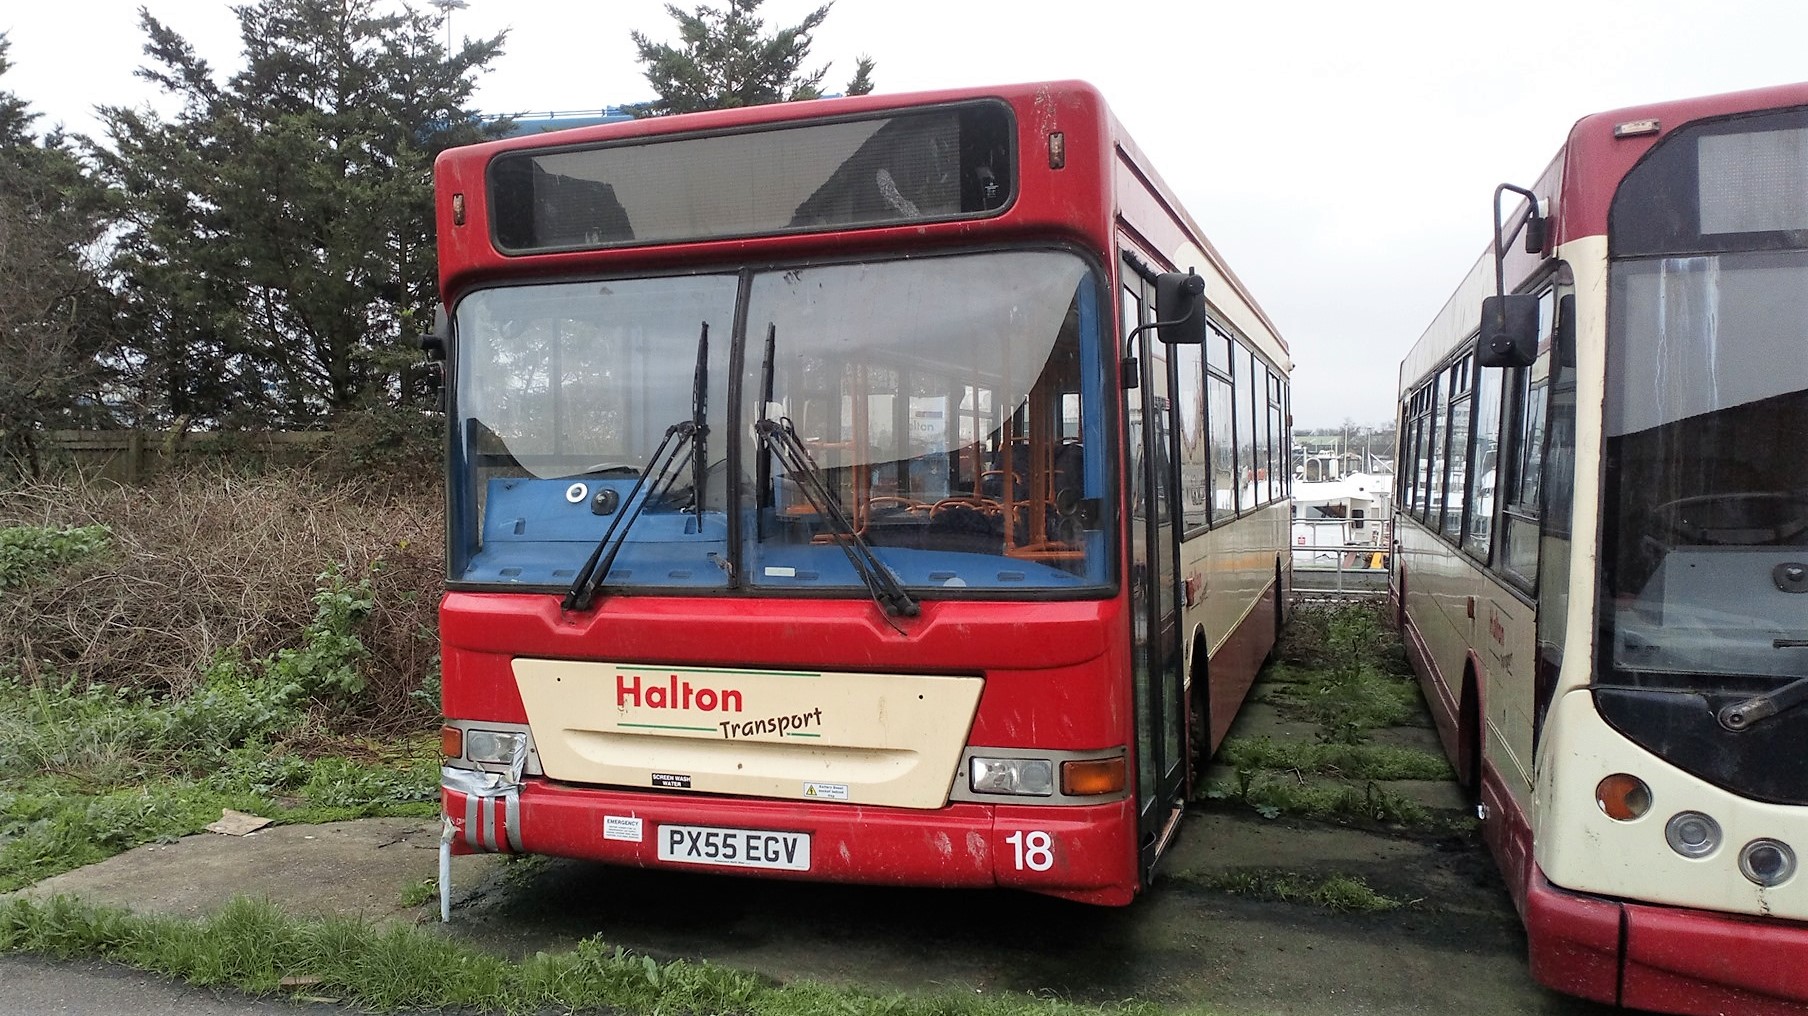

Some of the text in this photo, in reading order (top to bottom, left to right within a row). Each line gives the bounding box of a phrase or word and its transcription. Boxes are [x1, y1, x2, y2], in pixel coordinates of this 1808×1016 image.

[616, 675, 743, 712] Halton
[719, 707, 823, 739] Transport
[607, 818, 639, 827] EMERGENCY
[669, 829, 737, 859] PX55
[746, 835, 798, 864] EGV
[1005, 830, 1054, 872] 18
